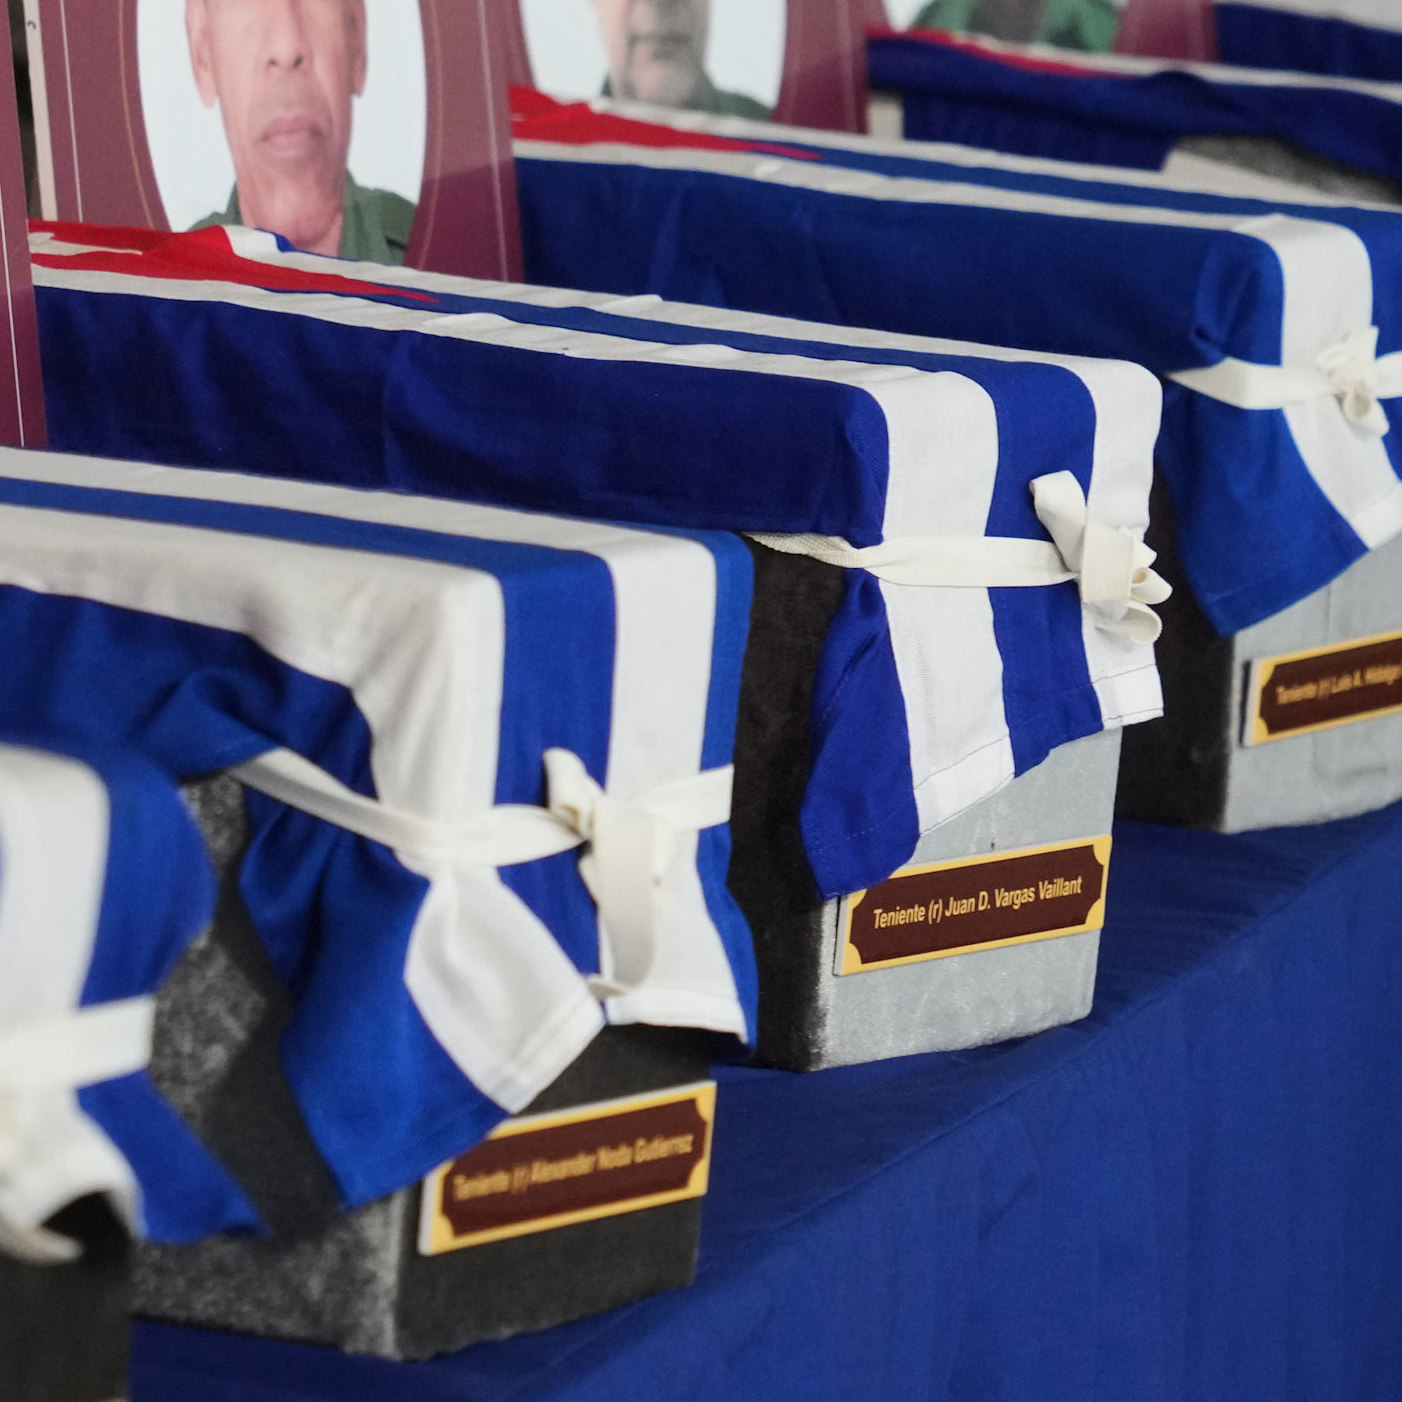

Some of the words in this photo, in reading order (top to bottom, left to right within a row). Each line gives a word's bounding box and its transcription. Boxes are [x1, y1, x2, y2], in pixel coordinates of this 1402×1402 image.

[873, 904, 926, 929] Teniente
[928, 899, 943, 925] (r)
[944, 895, 976, 917] Juan
[978, 890, 991, 912] D.
[994, 885, 1036, 910] Vargas
[1038, 875, 1083, 900] Vaillant
